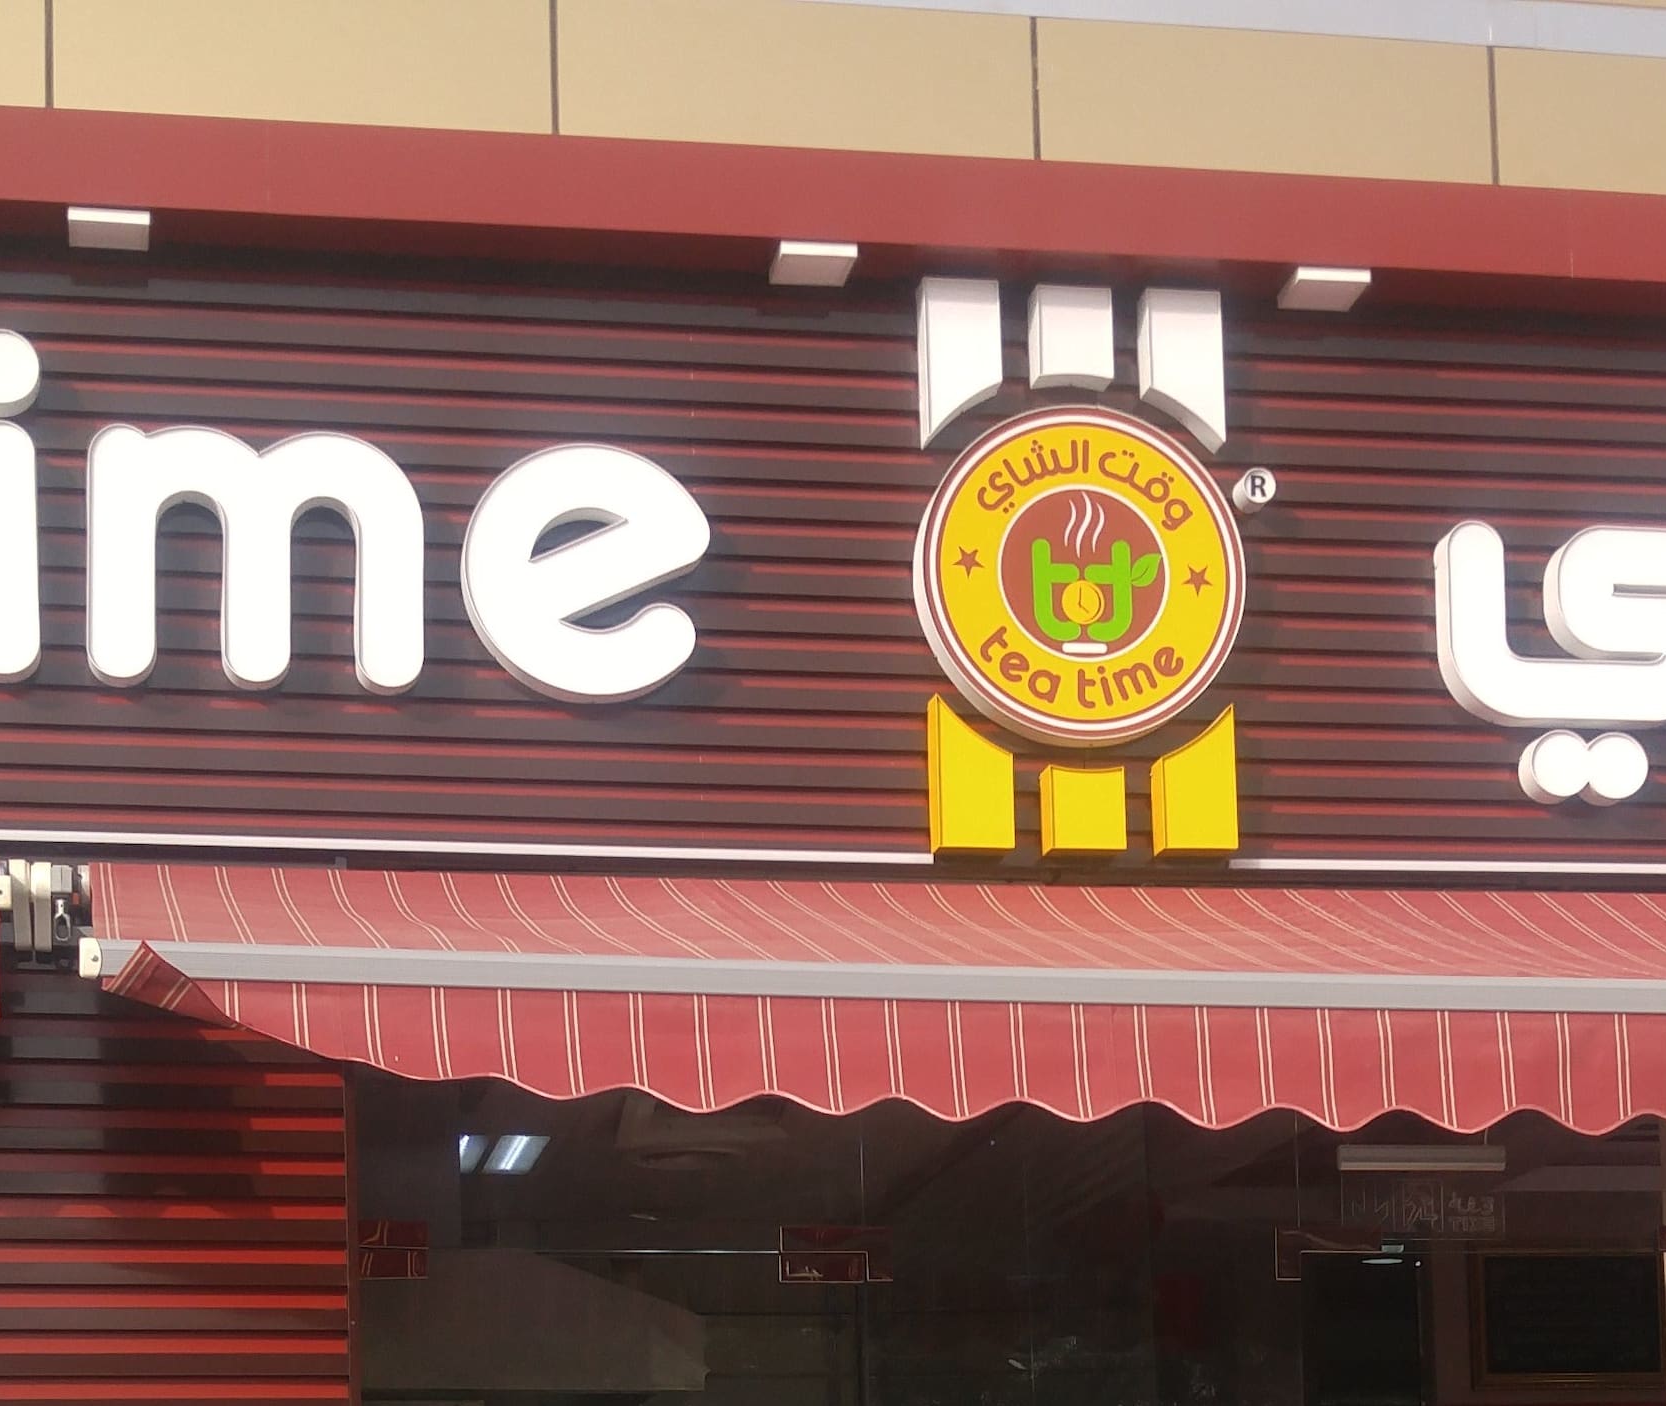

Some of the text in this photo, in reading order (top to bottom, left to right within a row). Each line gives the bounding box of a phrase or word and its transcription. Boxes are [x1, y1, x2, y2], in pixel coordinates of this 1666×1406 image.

[977, 439, 1194, 531] وقت الشاي
[980, 625, 1185, 709] tea time
